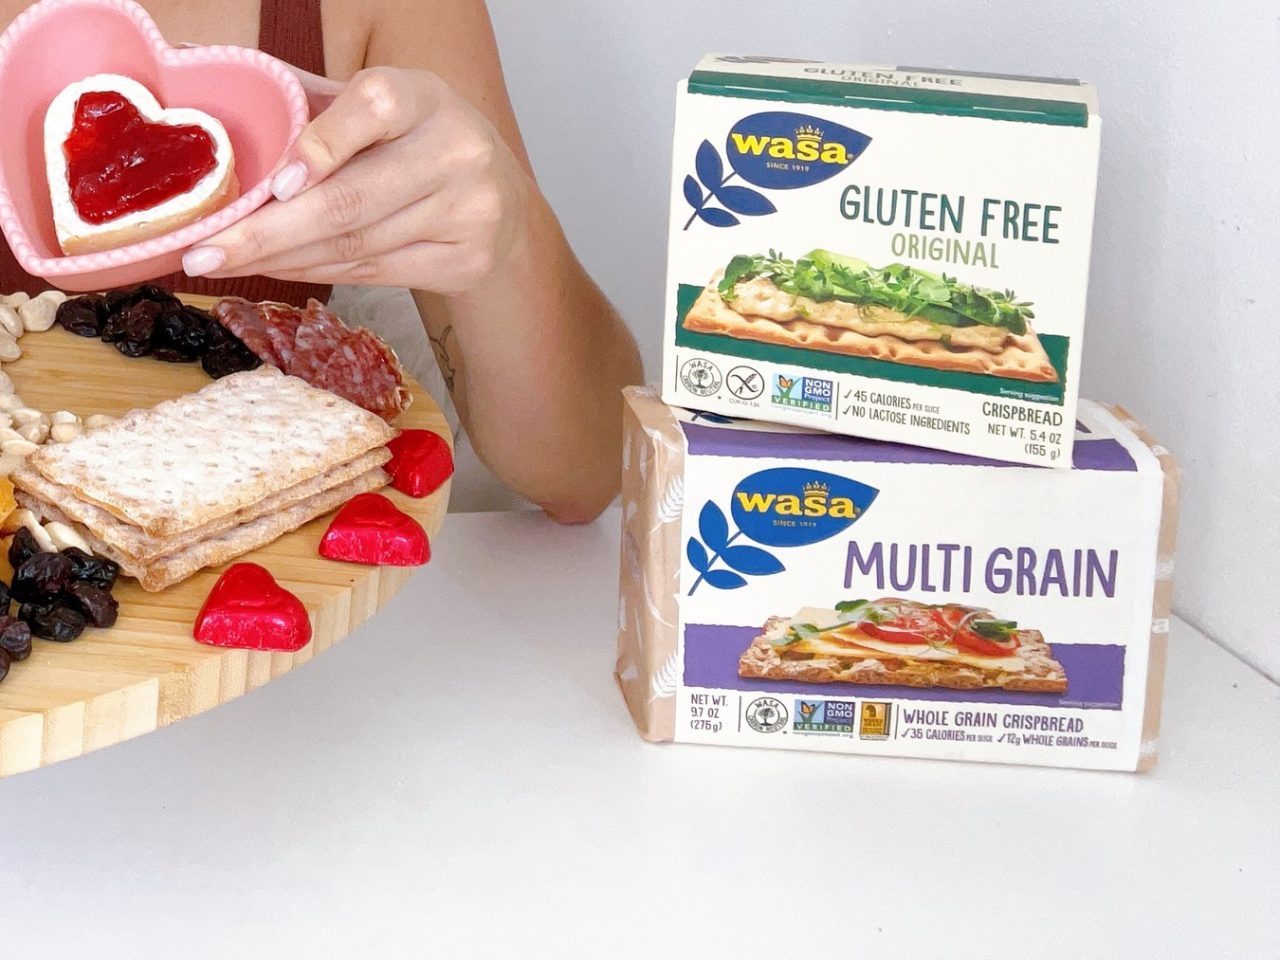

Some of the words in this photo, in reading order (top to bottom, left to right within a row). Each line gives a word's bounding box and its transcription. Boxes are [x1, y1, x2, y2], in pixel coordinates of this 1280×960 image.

[804, 67, 894, 80] GLUTEN
[906, 74, 962, 86] FREE
[841, 75, 919, 87] ORIGINAL
[731, 132, 849, 165] wasa
[766, 162, 789, 170] SINCE
[839, 184, 965, 234] GLUTEN
[981, 198, 1063, 244] FREE
[891, 233, 999, 269] ORIGINAL
[804, 386, 831, 396] GMO
[805, 379, 831, 389] NON
[774, 396, 830, 411] VERIFIED
[804, 392, 830, 403] Project
[853, 389, 868, 402] 45
[870, 392, 911, 410] CALORIES
[912, 402, 923, 411] PER
[924, 404, 940, 414] SLICE
[852, 405, 866, 417] NO
[869, 407, 907, 425] LACTOSE
[910, 414, 971, 435] INGREDIENTS
[982, 401, 1063, 427] CRISPBREAD
[987, 423, 1007, 437] NET
[1009, 426, 1026, 439] WT.
[1030, 429, 1046, 442] 5.4
[1048, 432, 1062, 445] OZ
[736, 492, 856, 519] wasa
[843, 540, 972, 592] MULTI
[985, 547, 1118, 598] GRAIN
[690, 693, 709, 705] NET
[754, 699, 780, 709] WASA
[827, 702, 853, 711] NON
[707, 707, 720, 719] OZ
[826, 709, 853, 718] GMO
[903, 708, 949, 726] WHOLE
[954, 711, 998, 728] GRAIN
[1003, 714, 1084, 733] CRISPBREAD
[796, 723, 852, 732] VERIFIED
[910, 728, 924, 739] 35
[926, 728, 966, 742] CALORIES
[1007, 732, 1021, 746] 12g
[1022, 733, 1054, 746] WHOLE
[1056, 735, 1089, 749] GRAINS
